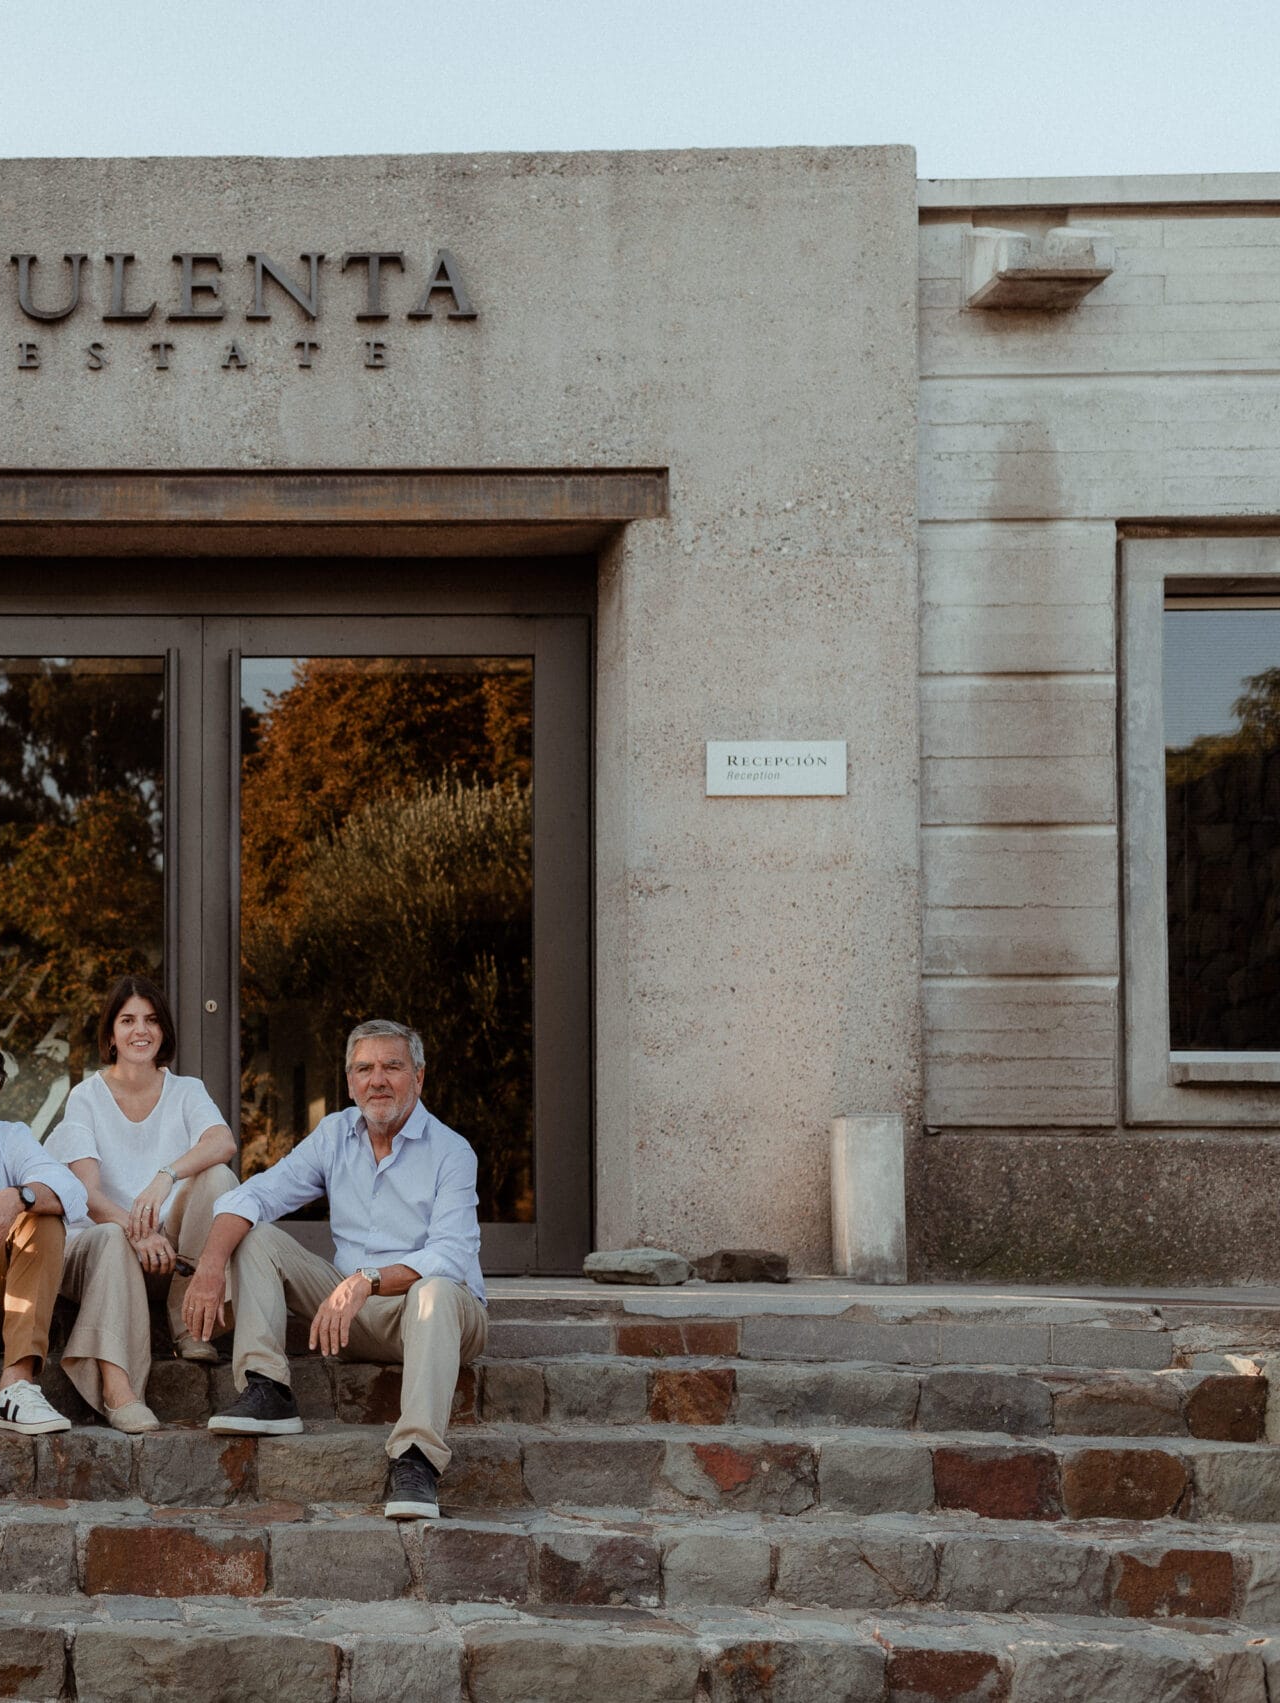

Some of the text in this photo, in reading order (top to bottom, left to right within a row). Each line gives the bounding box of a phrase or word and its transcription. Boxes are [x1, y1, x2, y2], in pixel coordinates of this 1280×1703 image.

[18, 341, 386, 369] ESTATE
[727, 754, 827, 766] RECEPCIÓN
[726, 771, 780, 781] Reception
